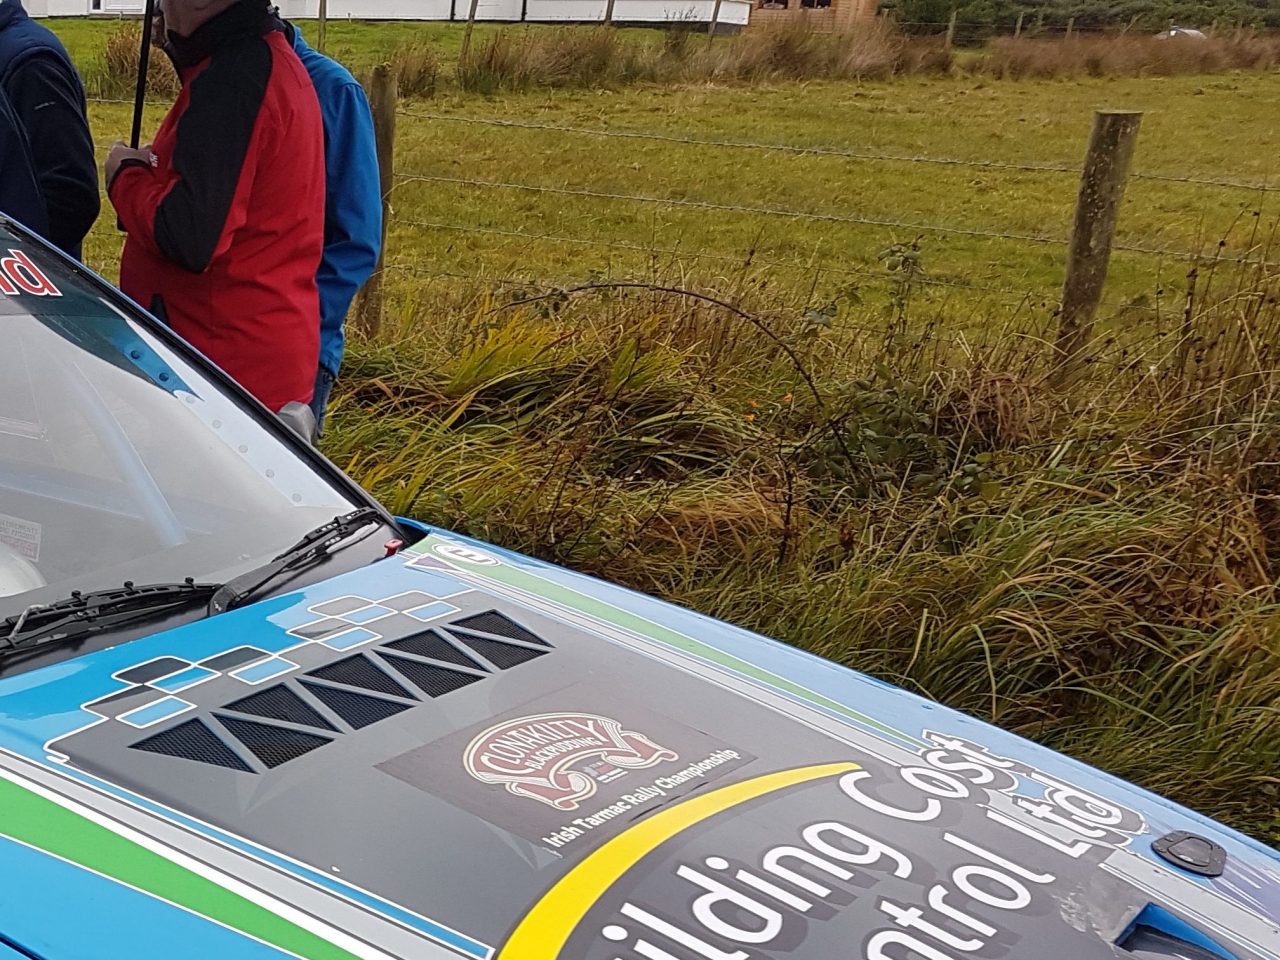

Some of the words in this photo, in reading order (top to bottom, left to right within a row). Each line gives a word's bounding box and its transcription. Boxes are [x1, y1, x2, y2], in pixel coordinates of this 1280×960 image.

[480, 719, 609, 775] CLONAKILTY
[838, 732, 1016, 822] Cost
[542, 825, 584, 847] Irish
[575, 800, 632, 830] Tarmac
[622, 782, 665, 806] Rally
[654, 748, 741, 789] Championship
[986, 771, 1123, 858] Ltd
